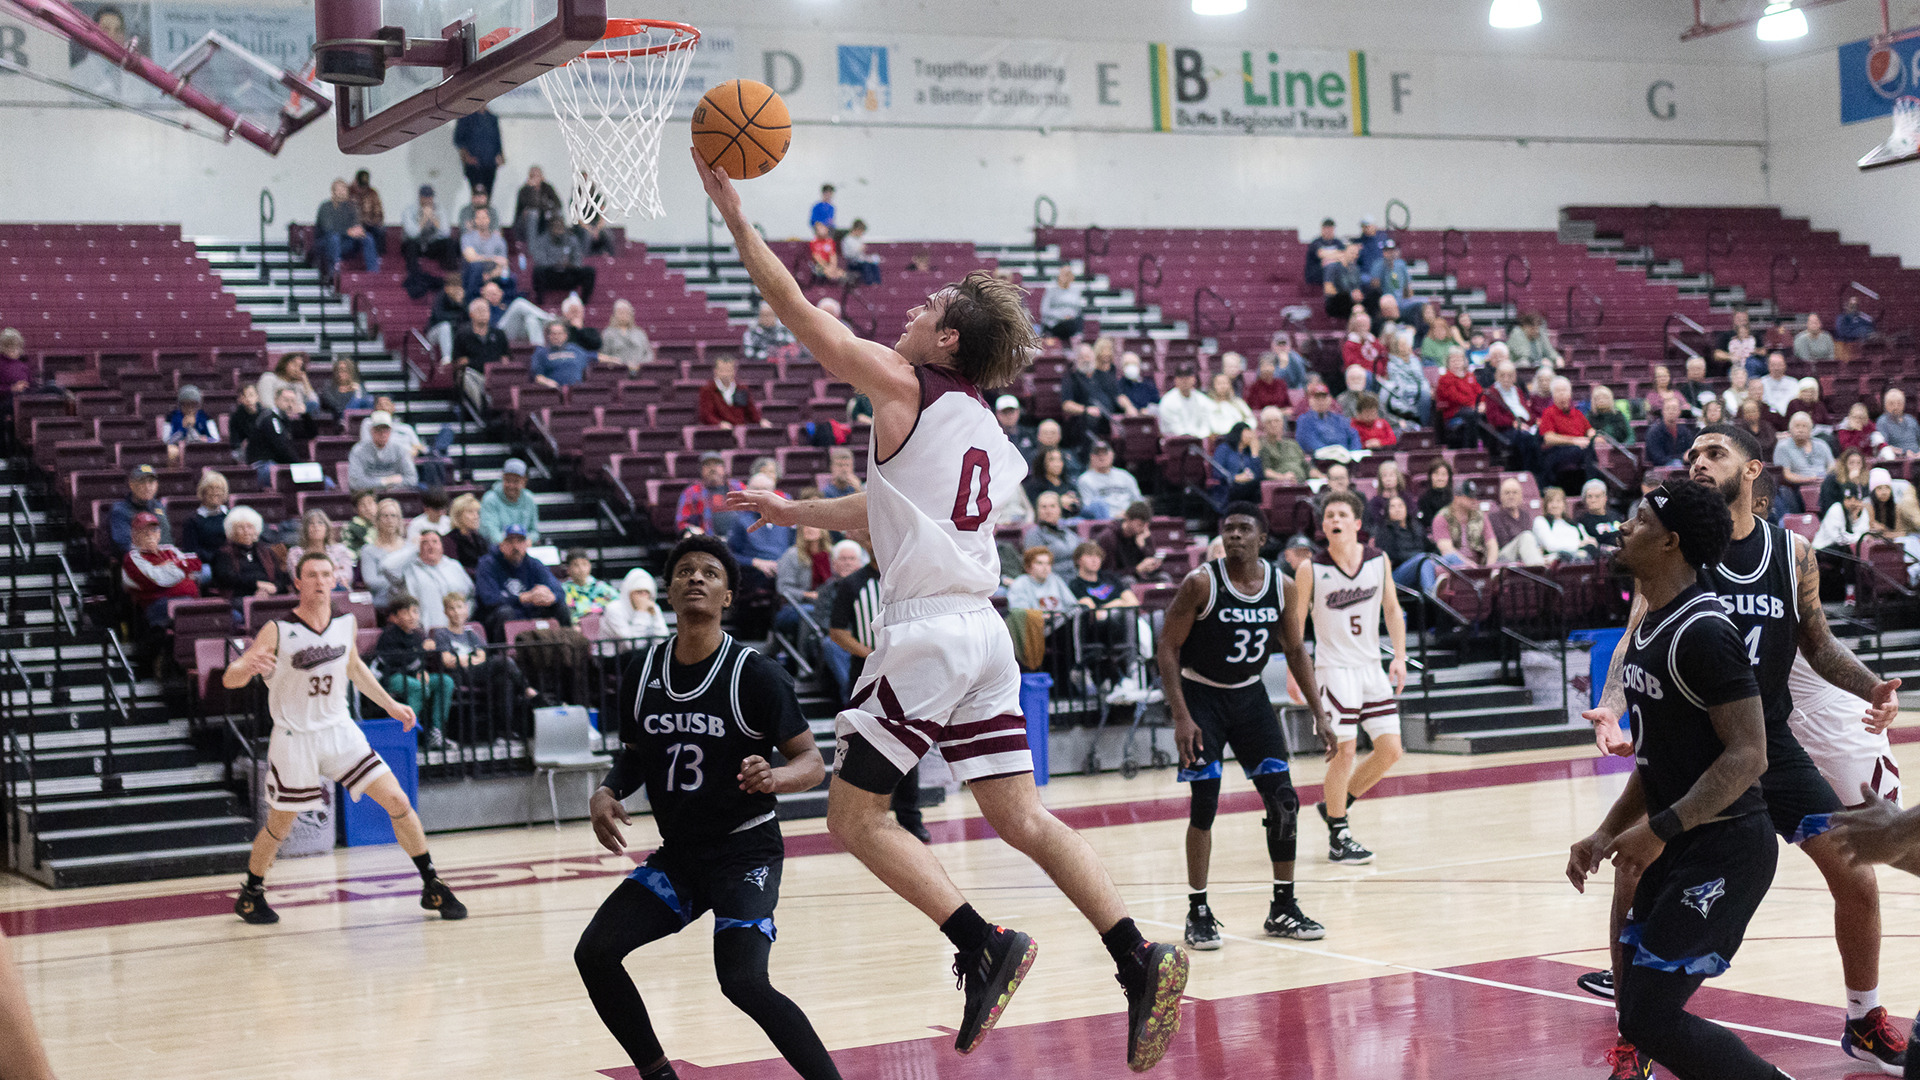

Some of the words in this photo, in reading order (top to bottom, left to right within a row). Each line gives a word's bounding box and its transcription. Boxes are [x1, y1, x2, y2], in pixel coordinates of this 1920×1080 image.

[763, 51, 803, 96] D
[998, 61, 1065, 83] Building
[1096, 62, 1121, 105] E
[1241, 50, 1346, 107] Line
[930, 86, 983, 105] Better
[987, 88, 1071, 107] California
[1391, 72, 1411, 113] F
[1646, 81, 1677, 120] G
[1176, 109, 1217, 127] Butte
[1221, 109, 1294, 133] Regional
[1299, 111, 1347, 129] Transit
[951, 446, 992, 532] 0
[1218, 607, 1279, 623] CSUSB
[1718, 594, 1785, 619] SUSB
[1349, 615, 1362, 635] 5
[1226, 628, 1269, 663] 33
[308, 675, 333, 697] 33
[1623, 663, 1664, 700] SUSB
[643, 712, 725, 738] CSUSB
[665, 743, 704, 792] 13
